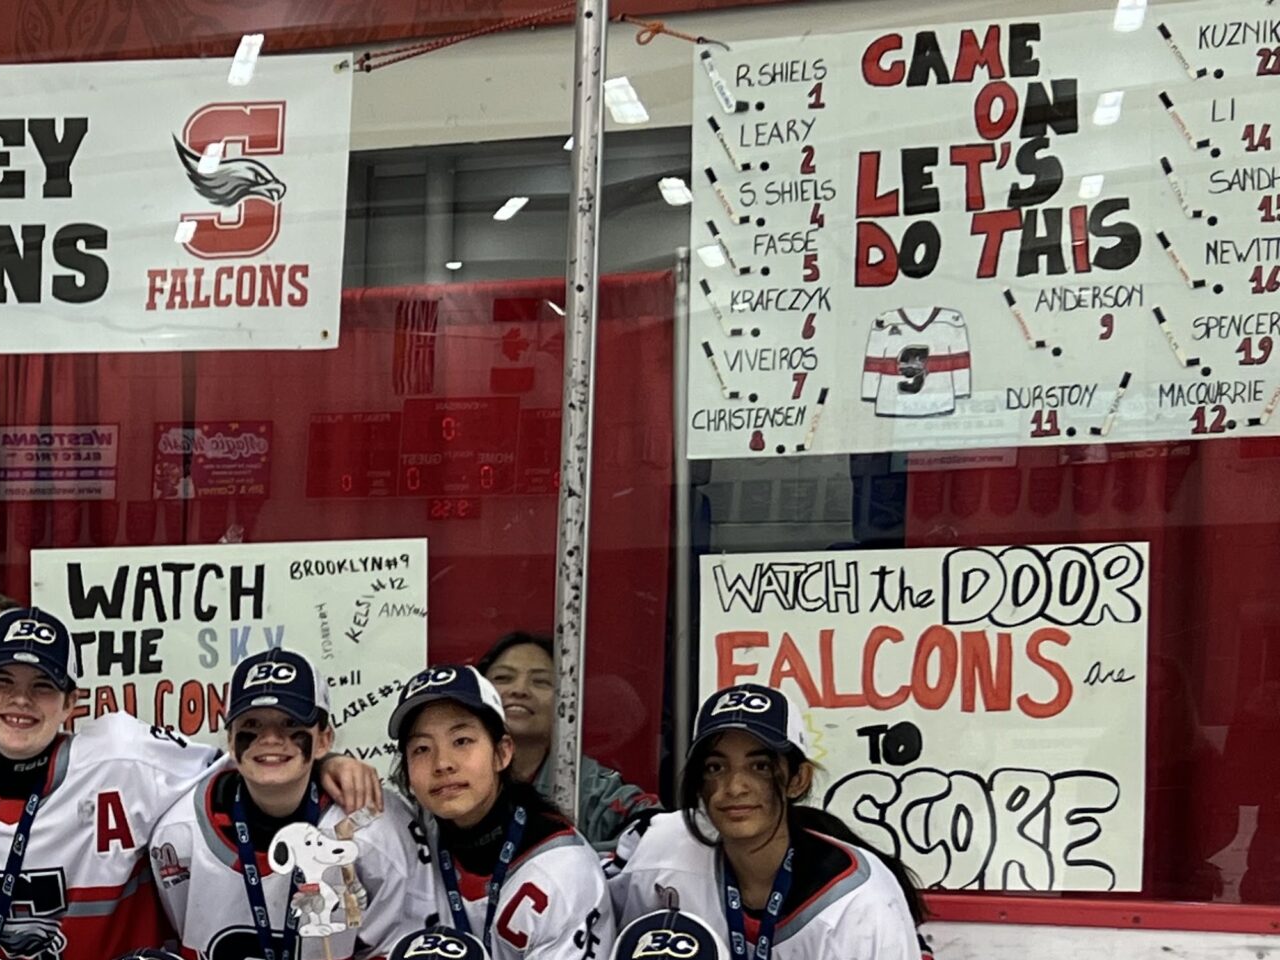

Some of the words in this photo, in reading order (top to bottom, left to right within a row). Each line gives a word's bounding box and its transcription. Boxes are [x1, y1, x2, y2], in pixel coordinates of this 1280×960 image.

[861, 22, 1041, 87] GAME
[808, 82, 825, 110] 1
[974, 78, 1078, 141] ON
[1211, 97, 1235, 122] LI
[740, 117, 816, 147] LEARY
[1241, 123, 1272, 152] 14
[800, 145, 816, 175] 2
[764, 179, 836, 206] SHIELS
[855, 137, 1064, 219] LET'S
[810, 202, 825, 228] 4
[1258, 194, 1280, 222] 1
[753, 228, 819, 256] FASSE
[854, 220, 941, 288] DO
[970, 197, 1142, 279] THIS
[803, 253, 820, 282] 5
[1249, 265, 1280, 294] 16
[146, 263, 310, 312] FALCONS
[730, 286, 831, 312] KRAFCZYK
[1034, 284, 1144, 313] ANDERSON
[802, 312, 817, 340] 6
[1099, 313, 1114, 340] 9
[1192, 312, 1280, 340] SPENCER
[724, 346, 818, 372] VIVEIROS
[1235, 336, 1273, 366] 19
[791, 372, 808, 400] 7
[1006, 383, 1098, 410] DURSTON
[691, 405, 807, 432] CHRISTENSEN
[1030, 410, 1061, 438] 11
[1189, 404, 1226, 434] 12
[67, 562, 265, 622] WATCH
[713, 559, 859, 614] WATCH
[870, 565, 935, 614] the
[942, 544, 1144, 627] DOOR
[3, 619, 57, 645] BC
[72, 628, 164, 678] THE
[243, 662, 297, 690] BC
[405, 665, 458, 699] BC
[714, 625, 1074, 719] FALCONS
[1083, 662, 1135, 686] are
[712, 690, 771, 714] BC
[857, 721, 923, 766] TO
[97, 790, 135, 853] A
[824, 767, 1120, 892] SCORE
[496, 881, 548, 949] C
[403, 934, 468, 959] BC
[632, 928, 700, 959] BC
